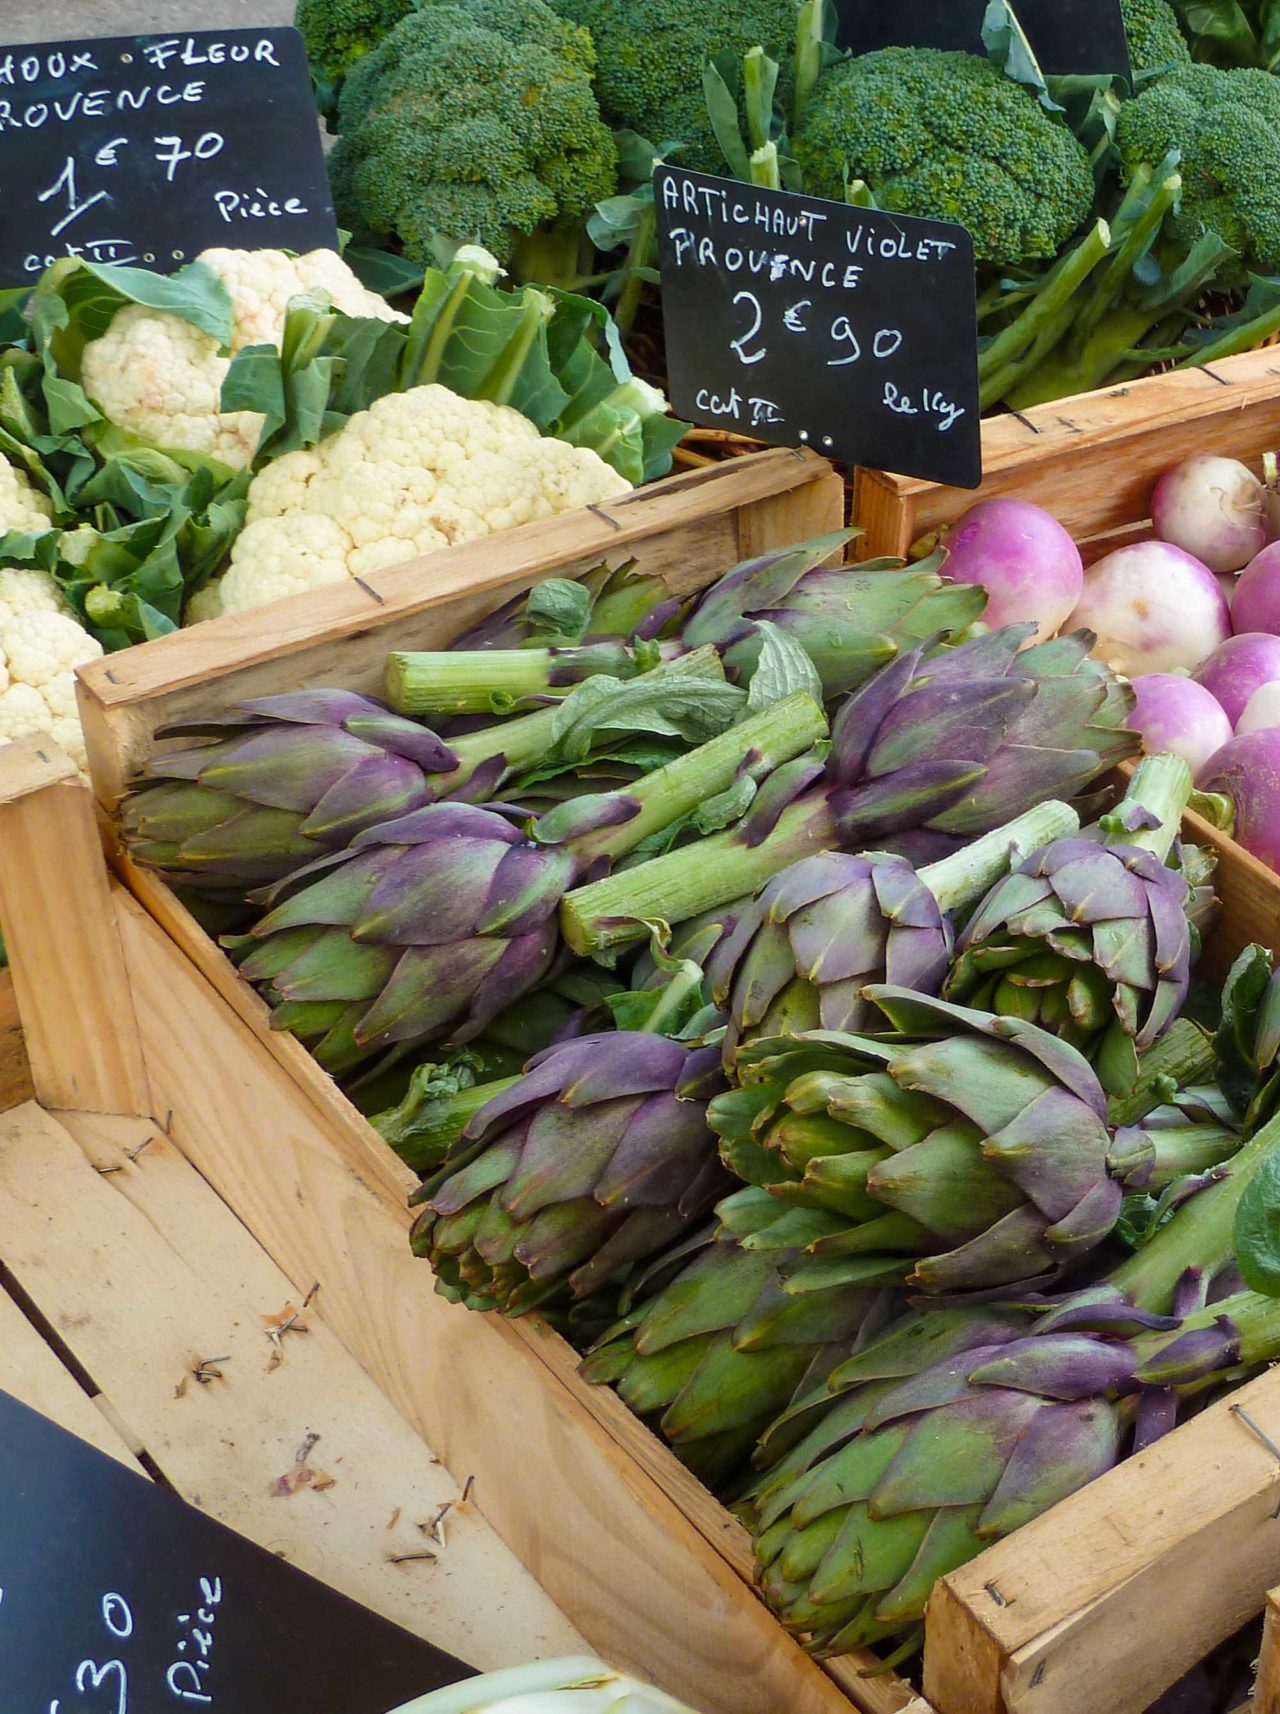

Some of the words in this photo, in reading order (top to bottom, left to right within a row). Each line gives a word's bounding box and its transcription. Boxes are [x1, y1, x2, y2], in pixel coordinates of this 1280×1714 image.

[0, 52, 98, 85] HOUX
[144, 39, 280, 69] FLEUR
[0, 81, 206, 130] ROVENCE
[214, 188, 309, 222] Pièce
[669, 228, 864, 288] PROVENCE
